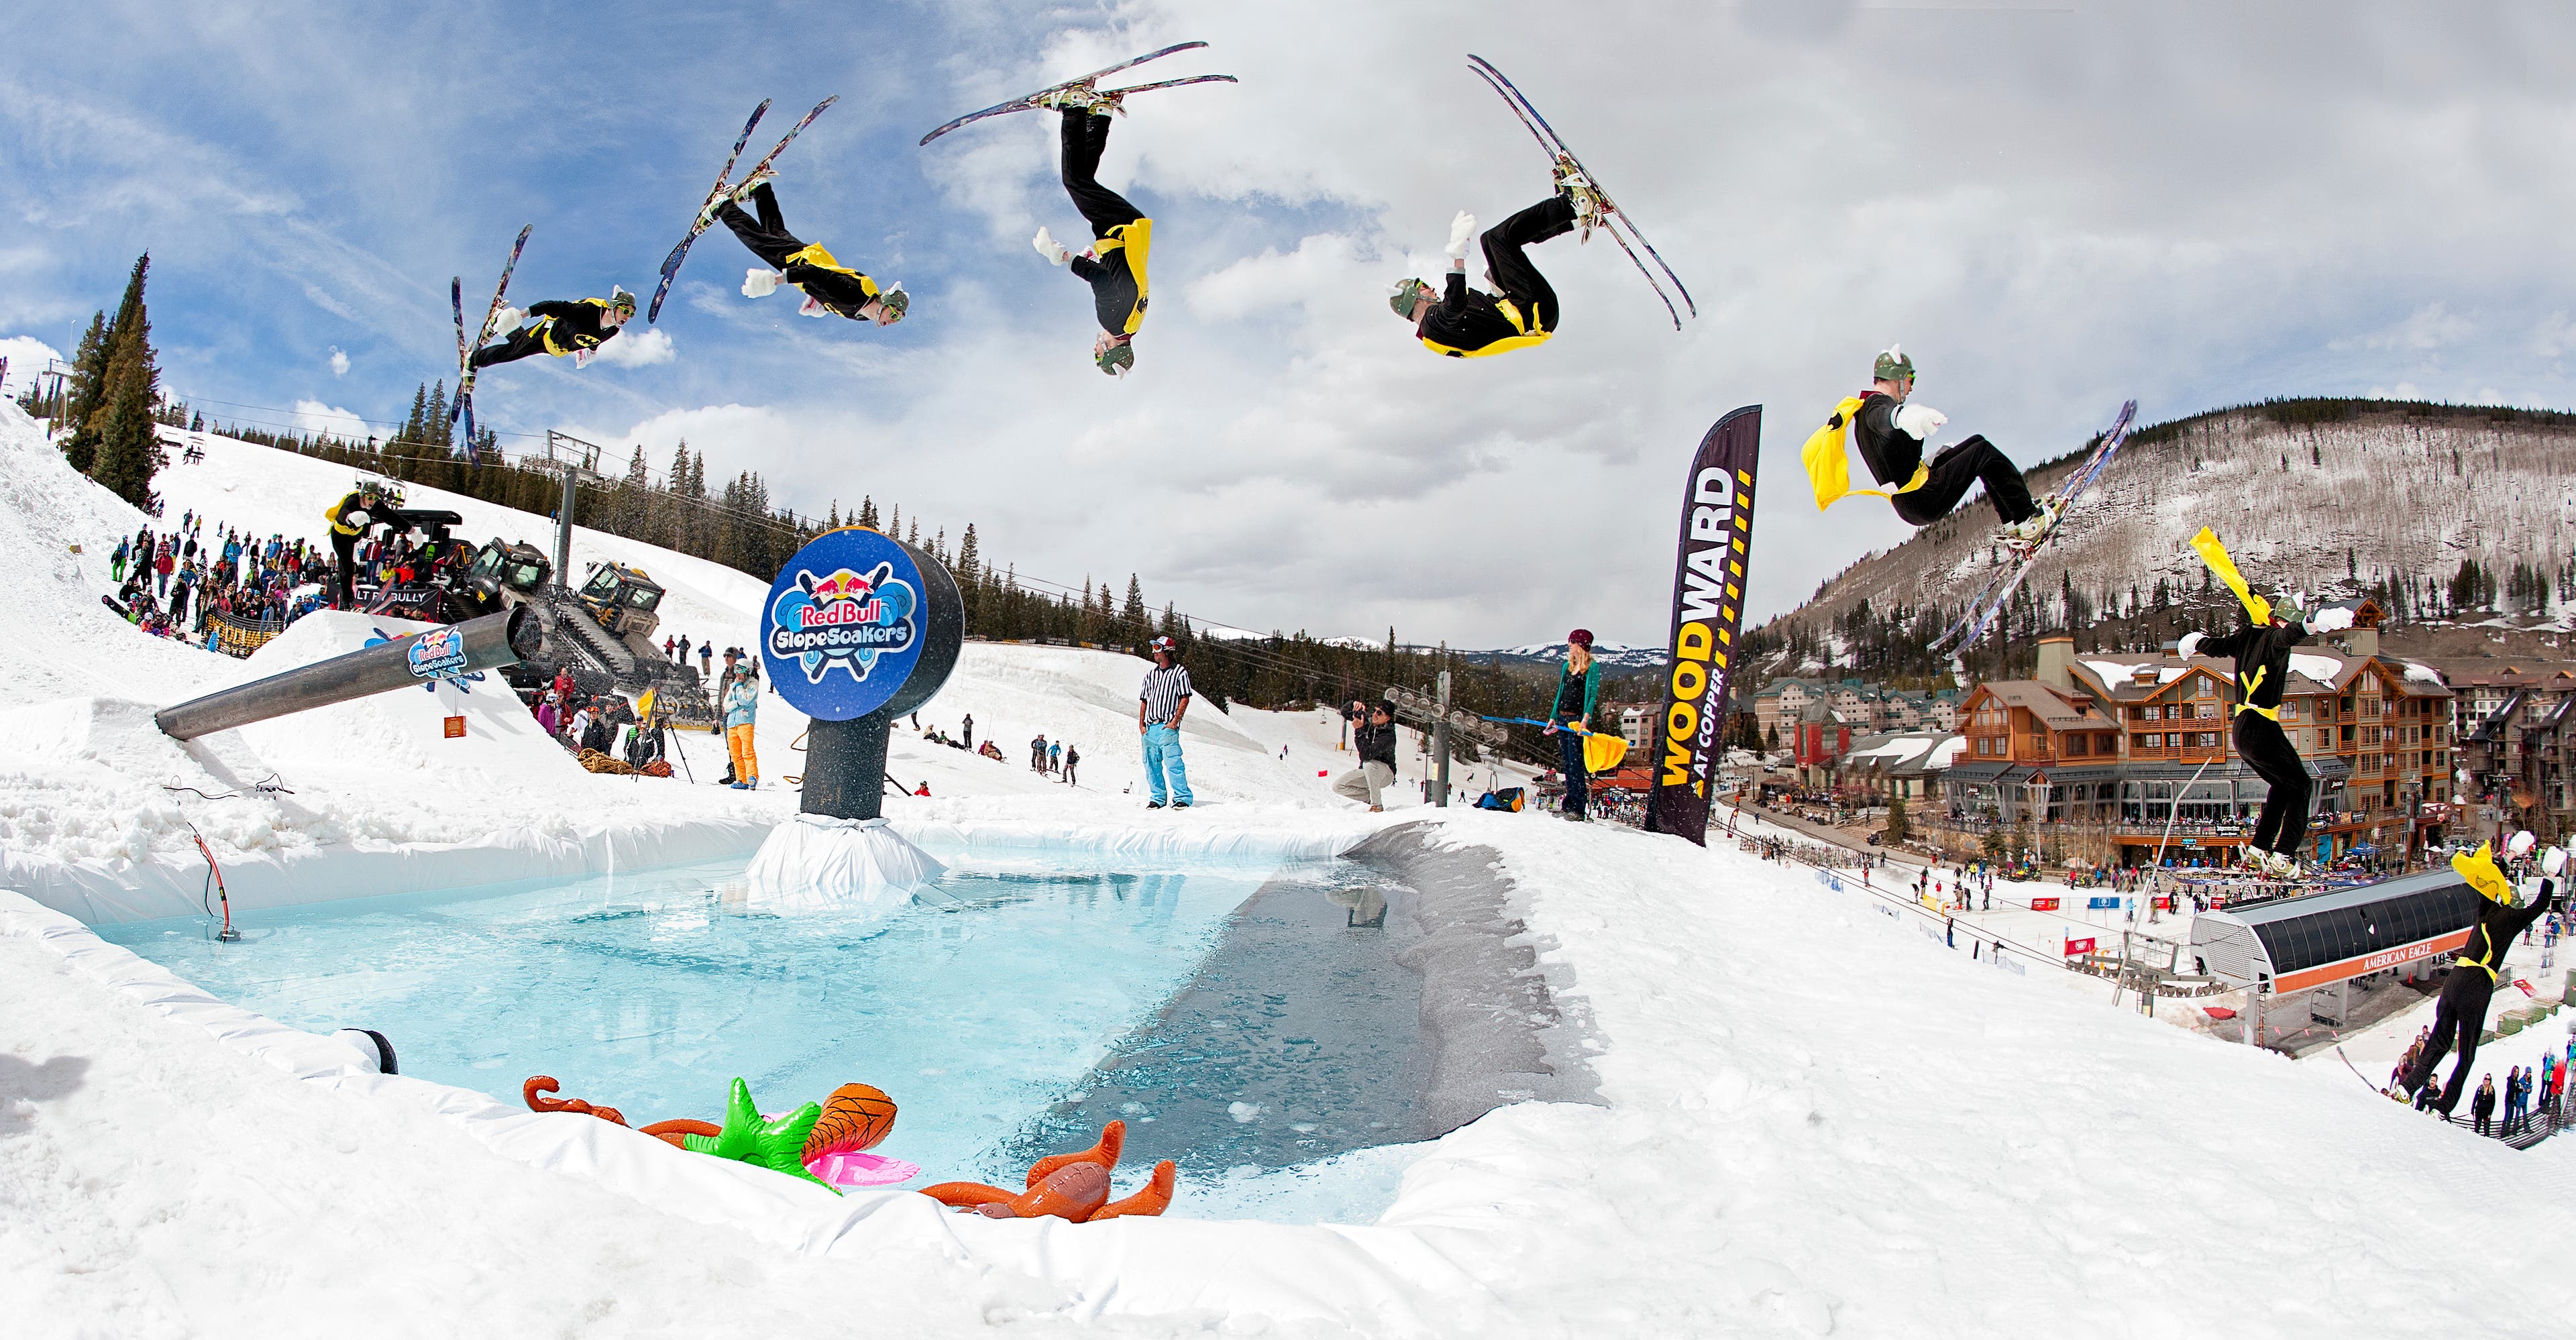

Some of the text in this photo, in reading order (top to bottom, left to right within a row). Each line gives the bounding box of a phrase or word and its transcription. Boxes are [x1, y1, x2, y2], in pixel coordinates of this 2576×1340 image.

[357, 591, 370, 600] LT
[390, 592, 427, 602] BULLY
[802, 600, 881, 626] Red Bull
[1662, 467, 1734, 787] WOODWARD
[419, 643, 450, 661] Red Bull
[1693, 668, 1725, 779] AT COPPER
[2363, 942, 2432, 970] AMERICAN EAGLE
